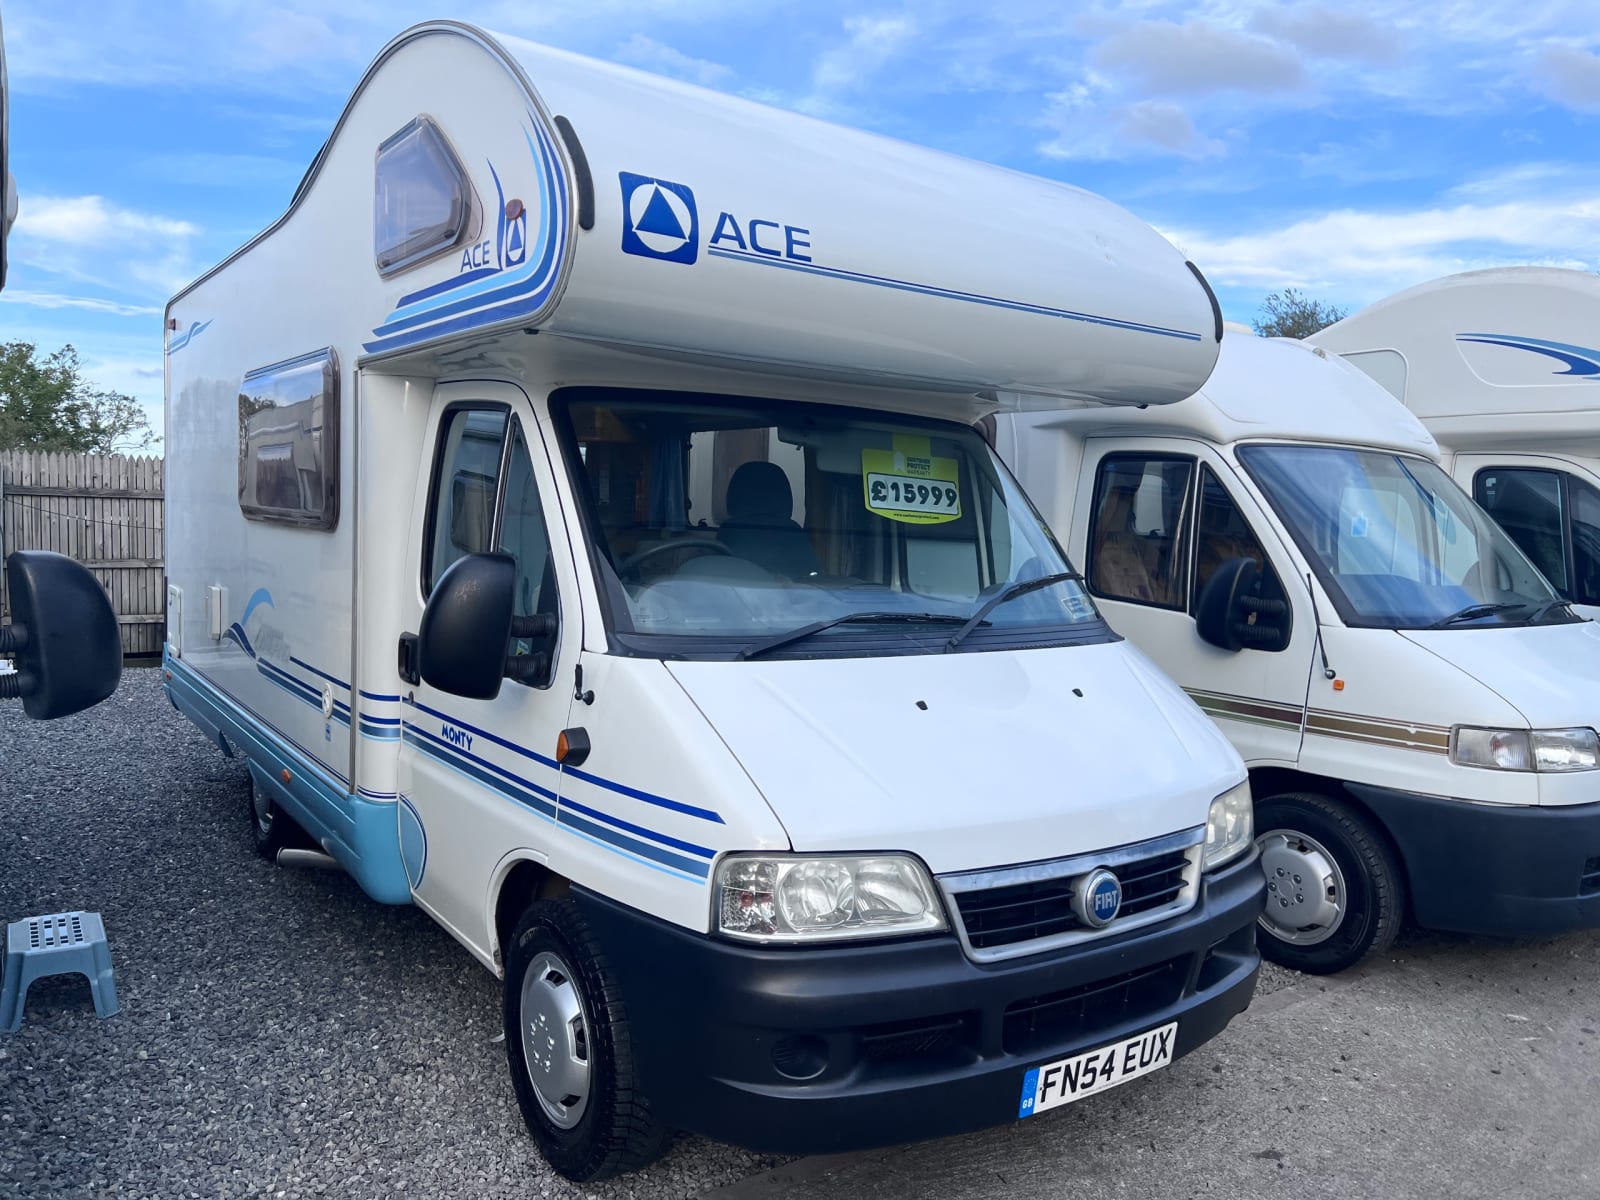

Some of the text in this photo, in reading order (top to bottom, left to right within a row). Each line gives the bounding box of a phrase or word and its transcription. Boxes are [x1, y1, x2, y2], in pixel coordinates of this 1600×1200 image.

[709, 211, 812, 263] ACE
[460, 240, 490, 273] ACE
[906, 462, 931, 471] PROTECT
[870, 480, 958, 508] £15999
[441, 723, 473, 751] MONTY
[1095, 890, 1118, 911] FIAT
[1040, 1049, 1116, 1104] FN54
[1121, 1028, 1173, 1076] EUX
[1022, 1097, 1033, 1110] GB
